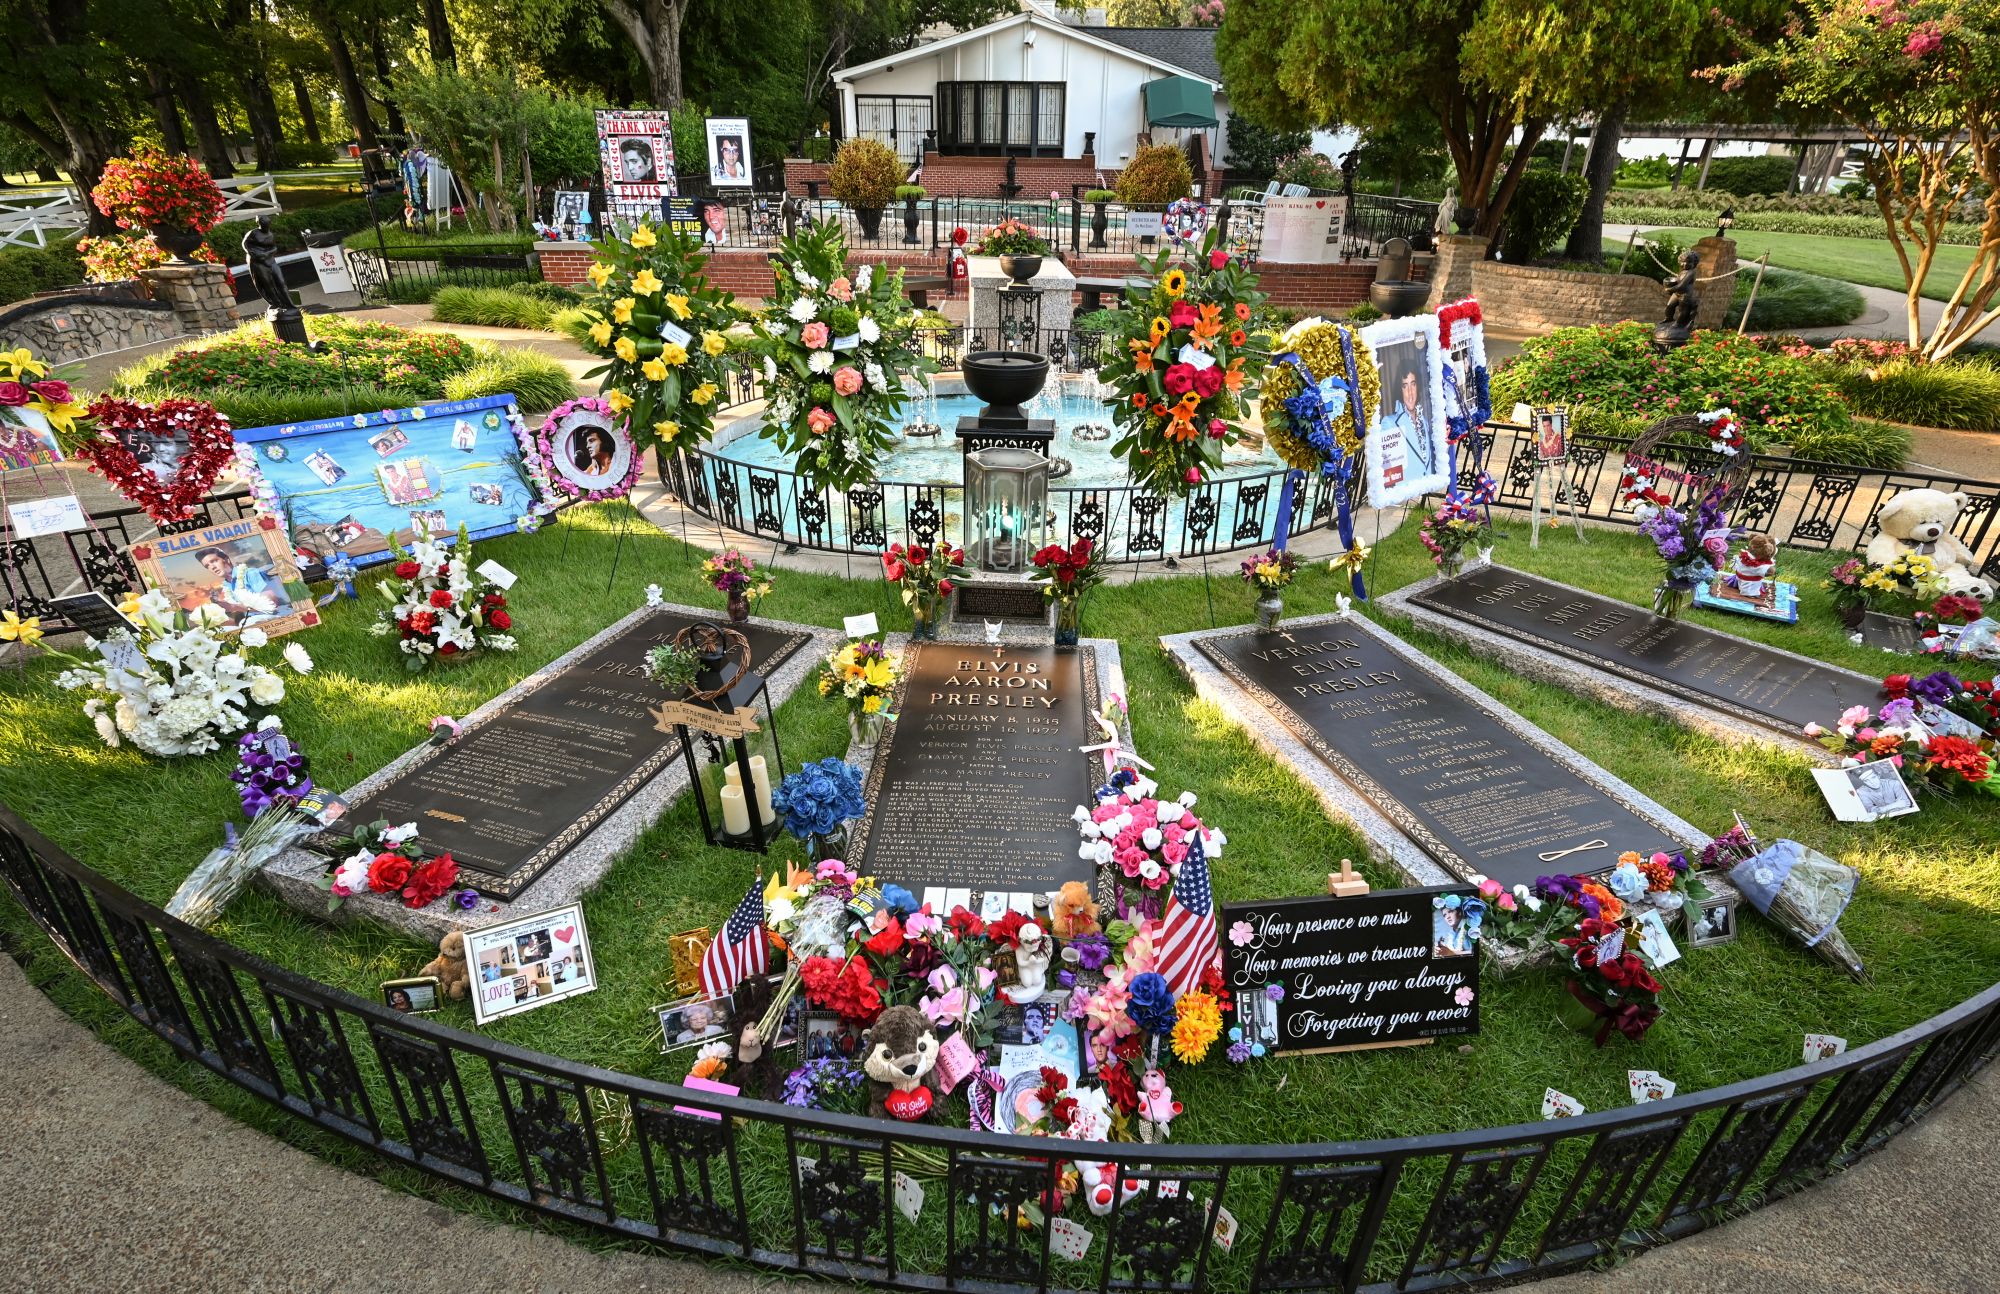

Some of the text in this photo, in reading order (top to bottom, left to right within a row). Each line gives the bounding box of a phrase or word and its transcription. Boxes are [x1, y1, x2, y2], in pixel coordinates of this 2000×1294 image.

[607, 120, 661, 134] THANK YOU
[620, 186, 662, 200] ELVIS
[1382, 442, 1399, 451] EMORY
[1660, 468, 1686, 483] KING
[1476, 580, 1531, 605] GLADYS
[1514, 593, 1556, 612] LOVE
[1544, 602, 1594, 626] SMITH
[1572, 610, 1632, 641] PRESLEY
[1251, 638, 1361, 662] VERNON
[958, 661, 1038, 674] ELVIS
[1292, 656, 1362, 677] ELVIS
[580, 686, 617, 697] JUNE
[945, 676, 1048, 691] AARON
[1293, 670, 1402, 698] PRESLEY
[564, 699, 598, 709] MAY
[611, 707, 645, 719] 1980
[931, 693, 1057, 709] PRESLEY
[1330, 698, 1366, 711] APRIL
[1389, 690, 1415, 700] 1916
[1340, 707, 1375, 720] JUNE
[1400, 698, 1428, 710] 1979
[924, 723, 992, 732] AUGUST
[1026, 727, 1060, 736] 1977
[925, 713, 1000, 723] JANUARY
[1026, 717, 1060, 726] 1935
[1011, 757, 1060, 765] PRESLEY
[1003, 771, 1052, 780] PRESLEY
[1246, 909, 1412, 950] Your presence we miss
[1231, 945, 1427, 986] Your memories we treasure
[482, 982, 512, 1003] LOVE
[1293, 965, 1466, 1004] Loving you always
[1243, 994, 1253, 1047] ELVIS
[1288, 1006, 1472, 1040] Forgetting you never
